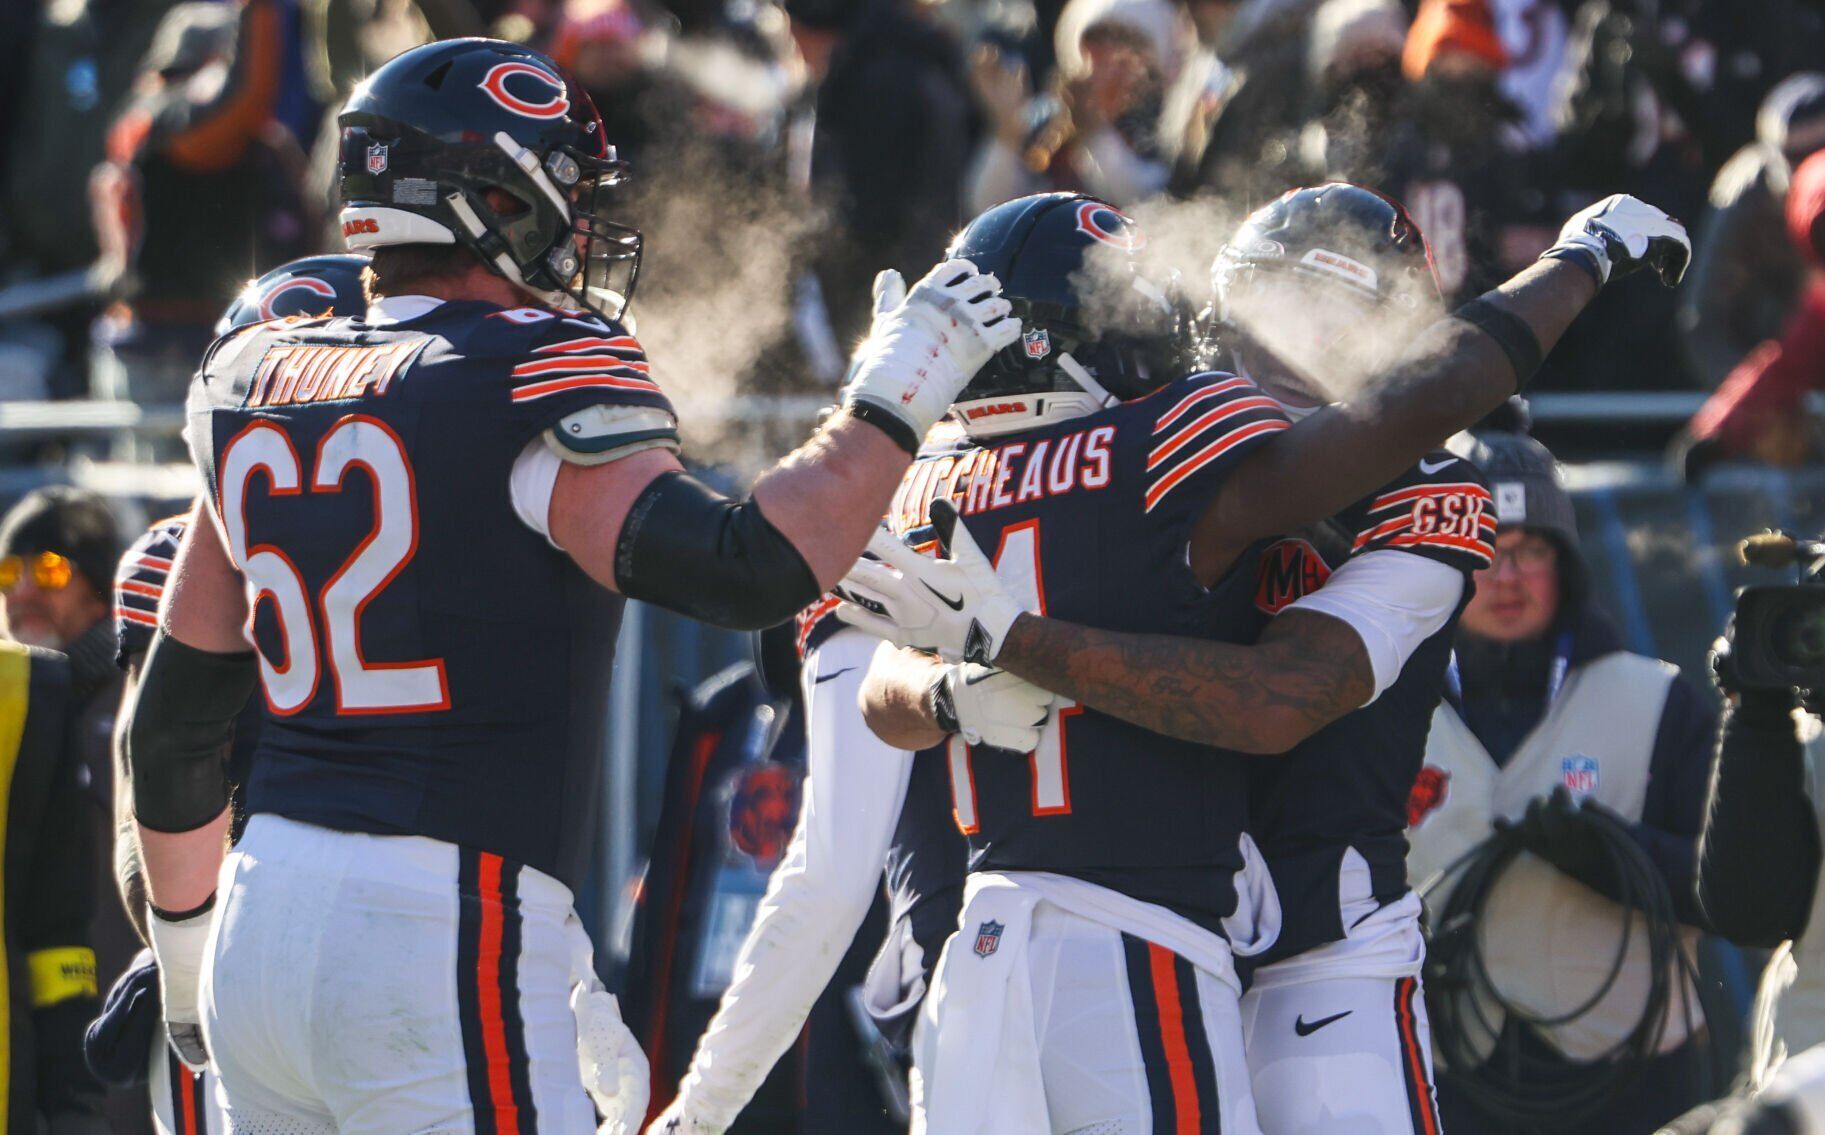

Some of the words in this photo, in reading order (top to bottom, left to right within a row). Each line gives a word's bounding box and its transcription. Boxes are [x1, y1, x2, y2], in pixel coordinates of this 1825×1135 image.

[248, 340, 428, 408] THUNEY
[965, 401, 1028, 420] BEARS
[1411, 493, 1485, 540] GSH
[216, 413, 452, 716] 62
